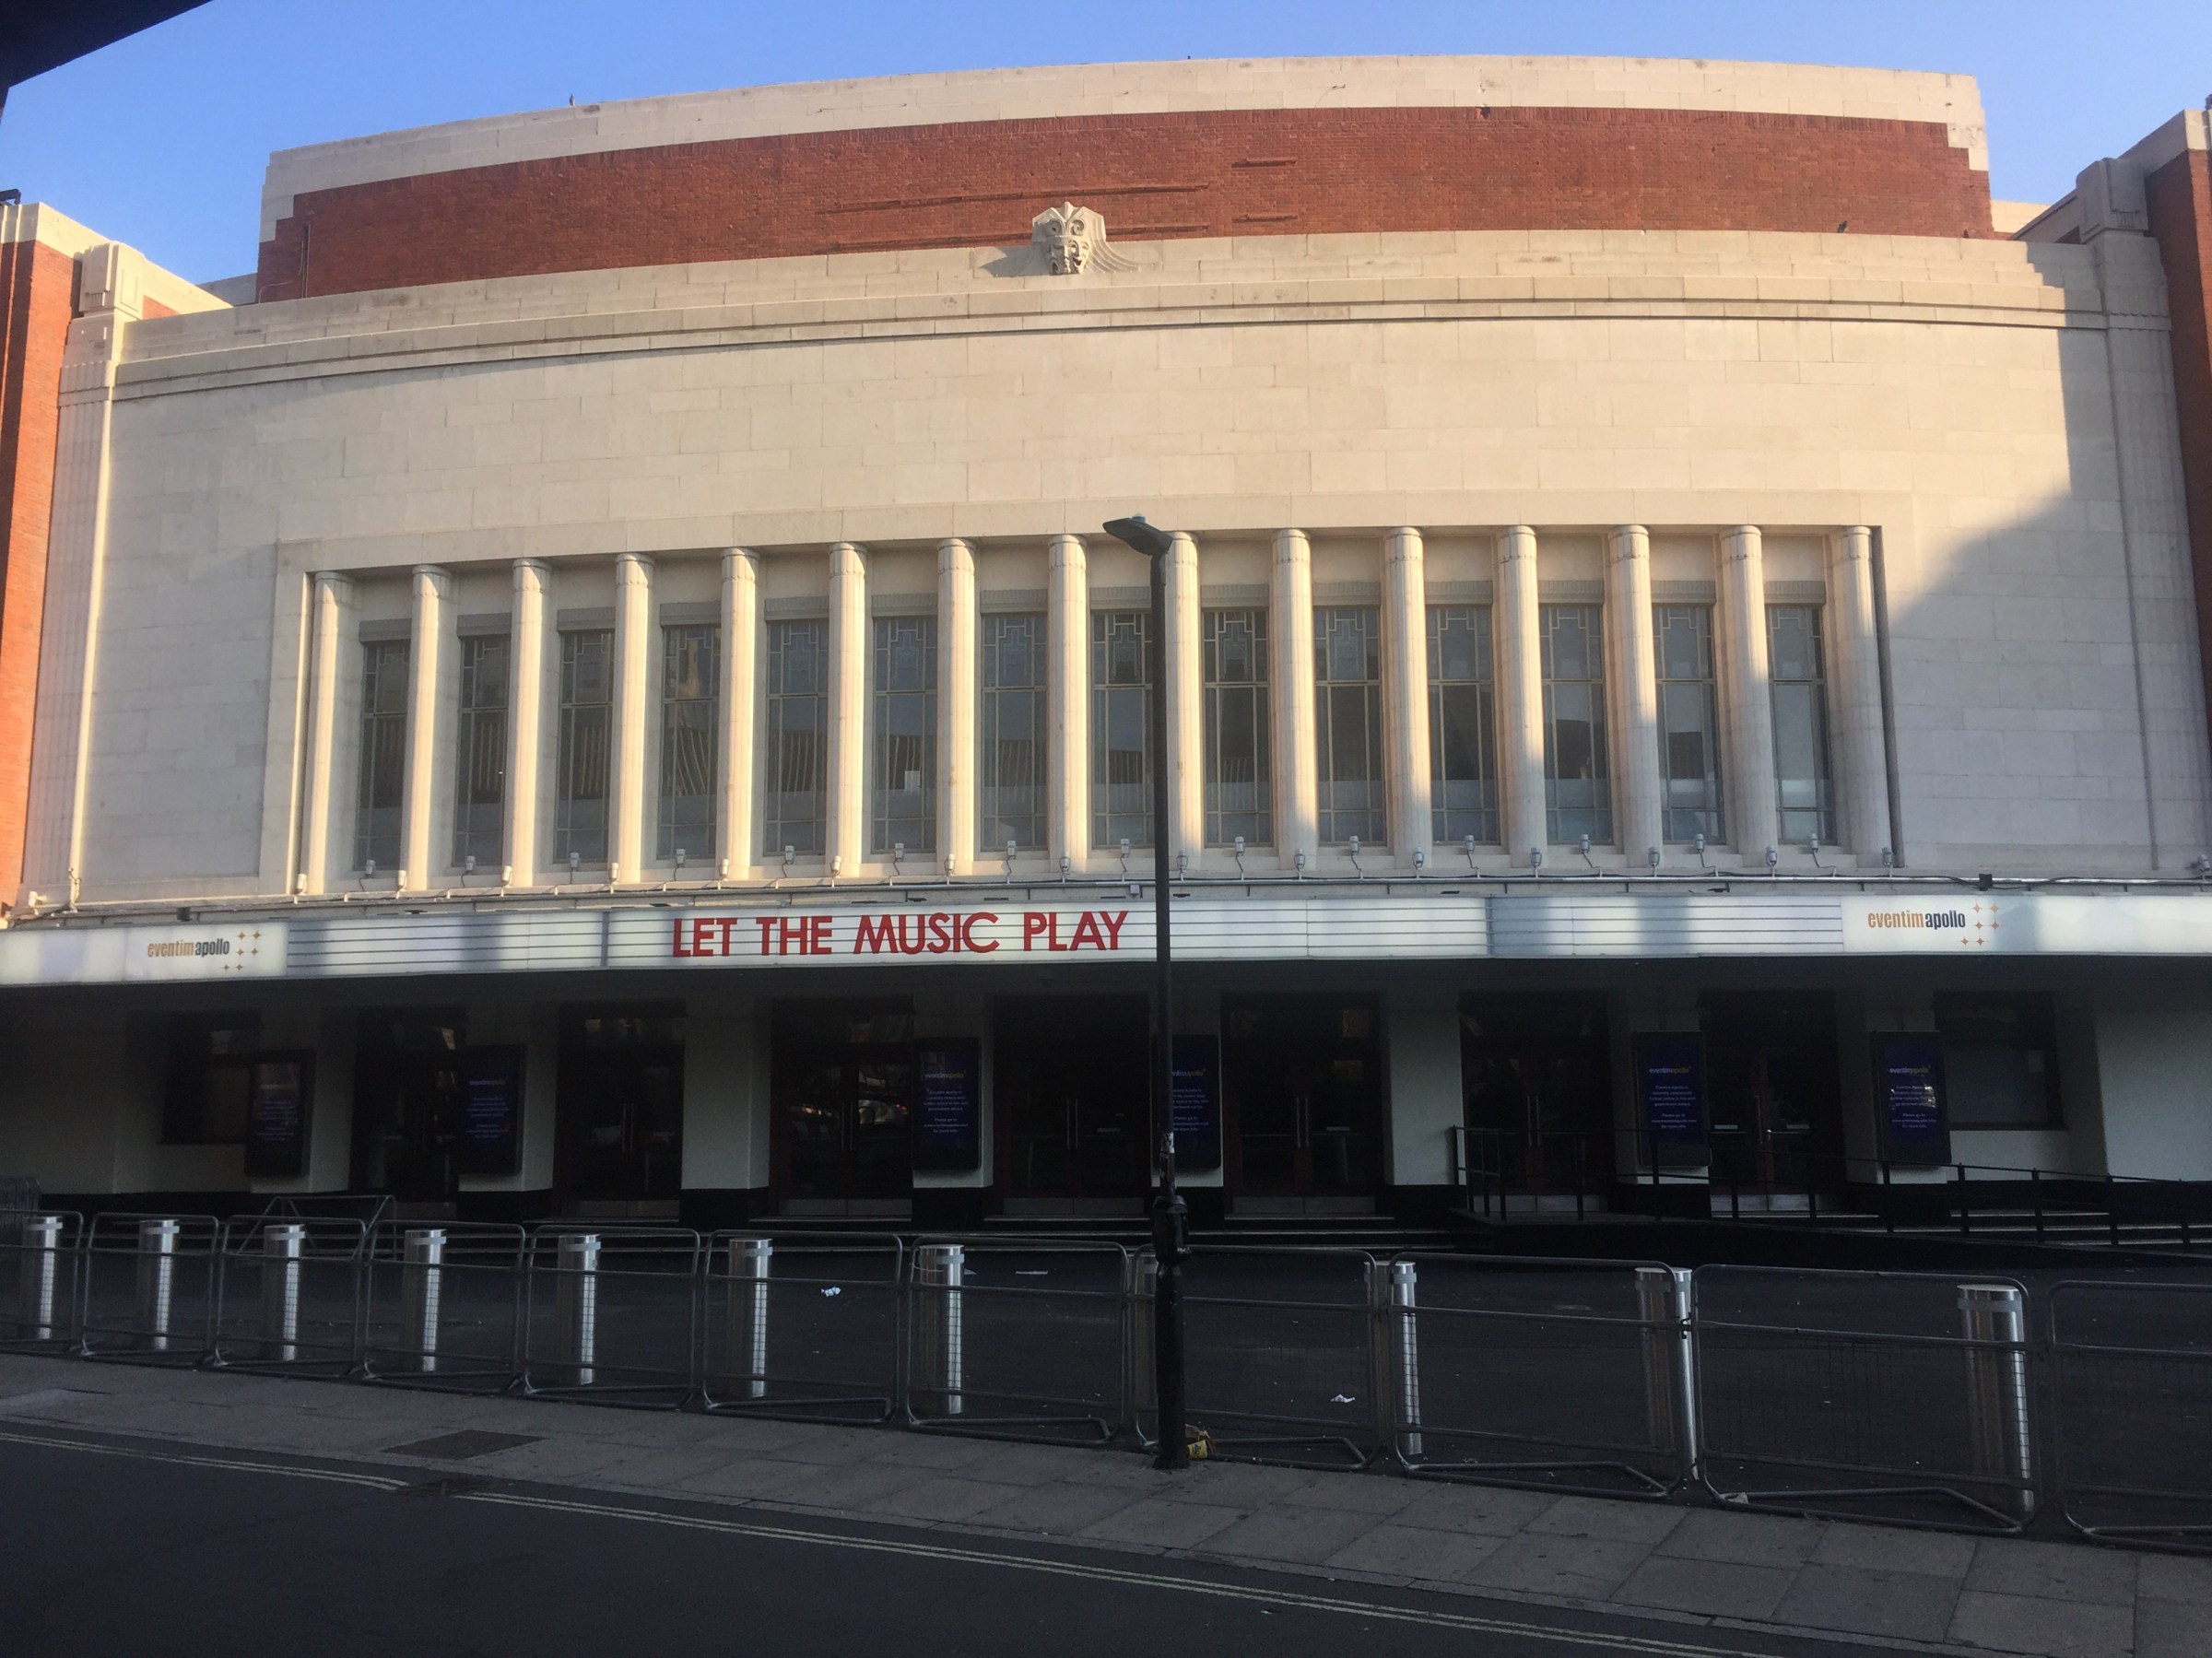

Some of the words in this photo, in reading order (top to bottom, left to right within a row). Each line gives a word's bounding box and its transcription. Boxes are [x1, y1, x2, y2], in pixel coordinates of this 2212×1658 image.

[1867, 910, 1966, 930] eventimapollo
[672, 917, 737, 958] LET
[756, 915, 833, 957] THE
[853, 911, 1001, 955] MUSIC
[1023, 911, 1129, 952] PLAY
[147, 938, 230, 958] eventimapollo
